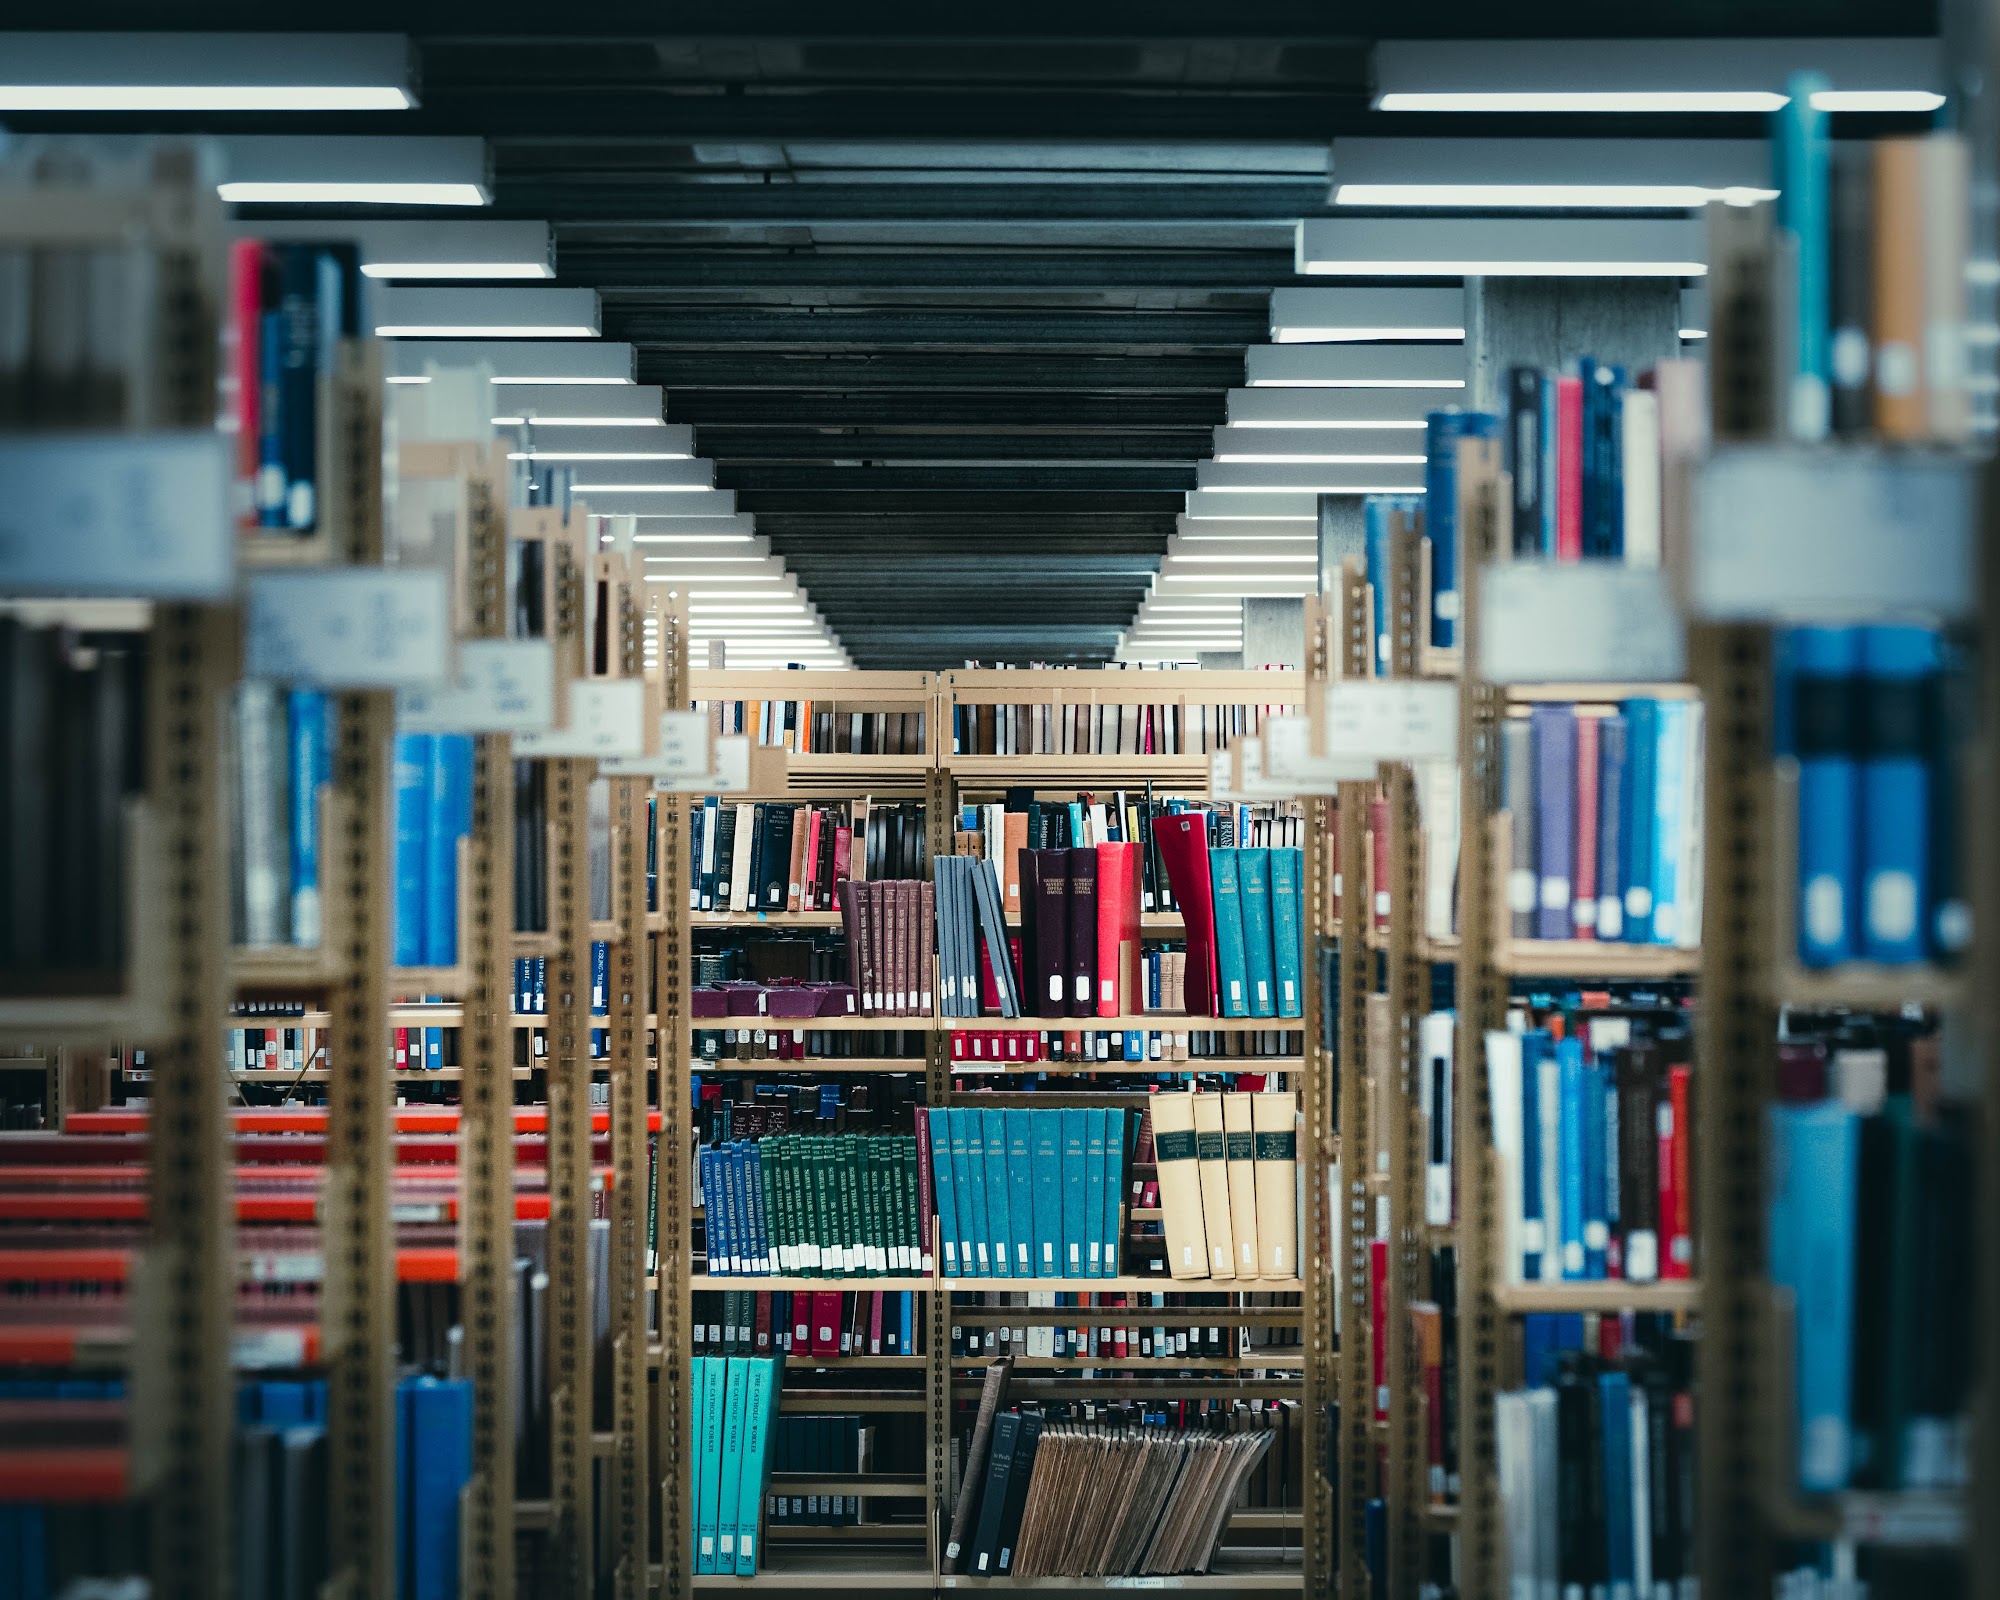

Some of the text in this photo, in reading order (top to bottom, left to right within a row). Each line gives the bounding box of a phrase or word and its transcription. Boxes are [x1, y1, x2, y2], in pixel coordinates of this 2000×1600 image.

[725, 1162, 734, 1193] COLLECTED
[744, 1161, 752, 1192] COLLECTED
[704, 1158, 712, 1192] COLLECTED
[709, 1225, 714, 1233] OF
[726, 1195, 736, 1219] TANTRAS
[746, 1193, 754, 1218] TANTRAS
[755, 1194, 763, 1219] TANTRAS
[729, 1220, 737, 1228] OF
[749, 1219, 755, 1227] OF
[731, 1389, 739, 1422] CATHOLIC
[752, 1389, 760, 1423] CATHOLIC
[750, 1426, 758, 1453] WORKER
